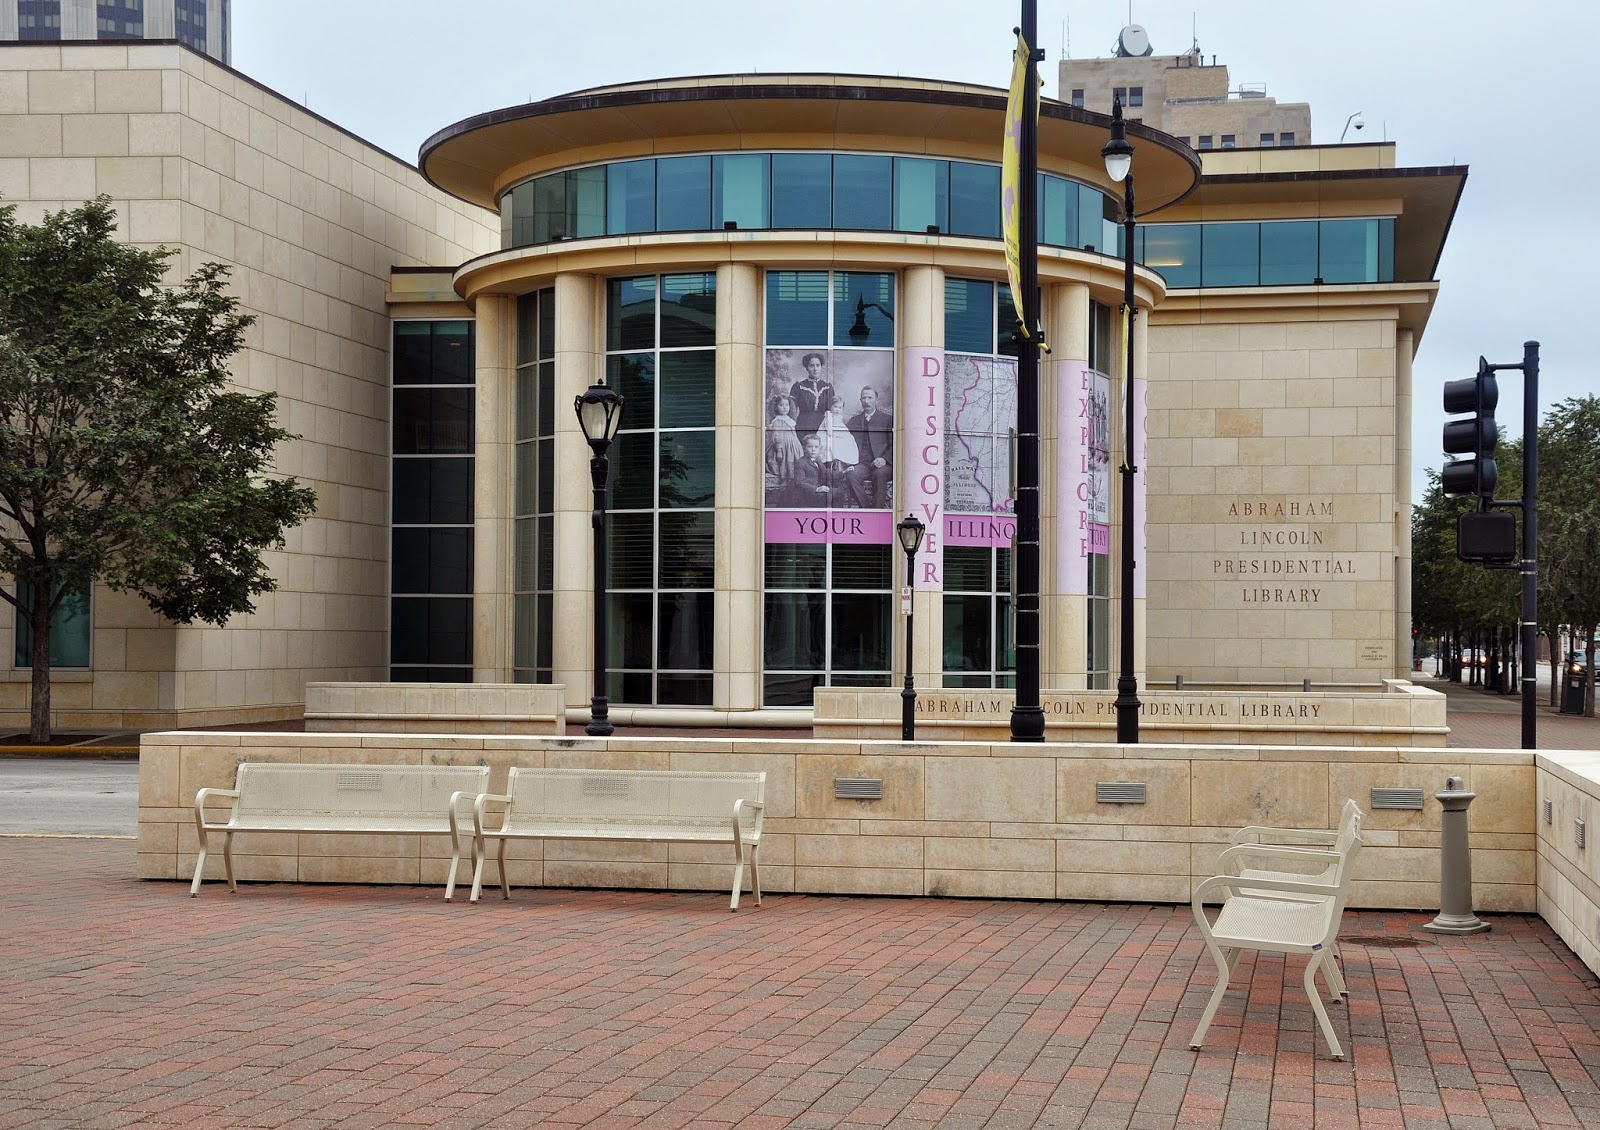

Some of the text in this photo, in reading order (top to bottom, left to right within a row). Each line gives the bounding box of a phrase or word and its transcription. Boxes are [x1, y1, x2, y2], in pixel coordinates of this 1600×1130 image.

[920, 356, 941, 583] DISCOVER
[1077, 370, 1088, 557] EXPLORE
[1228, 502, 1333, 516] ABRAHAM
[794, 517, 865, 535] YOUR
[949, 520, 1016, 540] ILLINO
[1089, 528, 1107, 547] TORY
[1240, 530, 1324, 545] LINCOLN
[1213, 560, 1356, 574] PRESIDENTIAL
[1242, 588, 1321, 602] LIBRARY
[915, 700, 1321, 717] ABRAHAM COLN PRIDENTIAL LIBRARY
